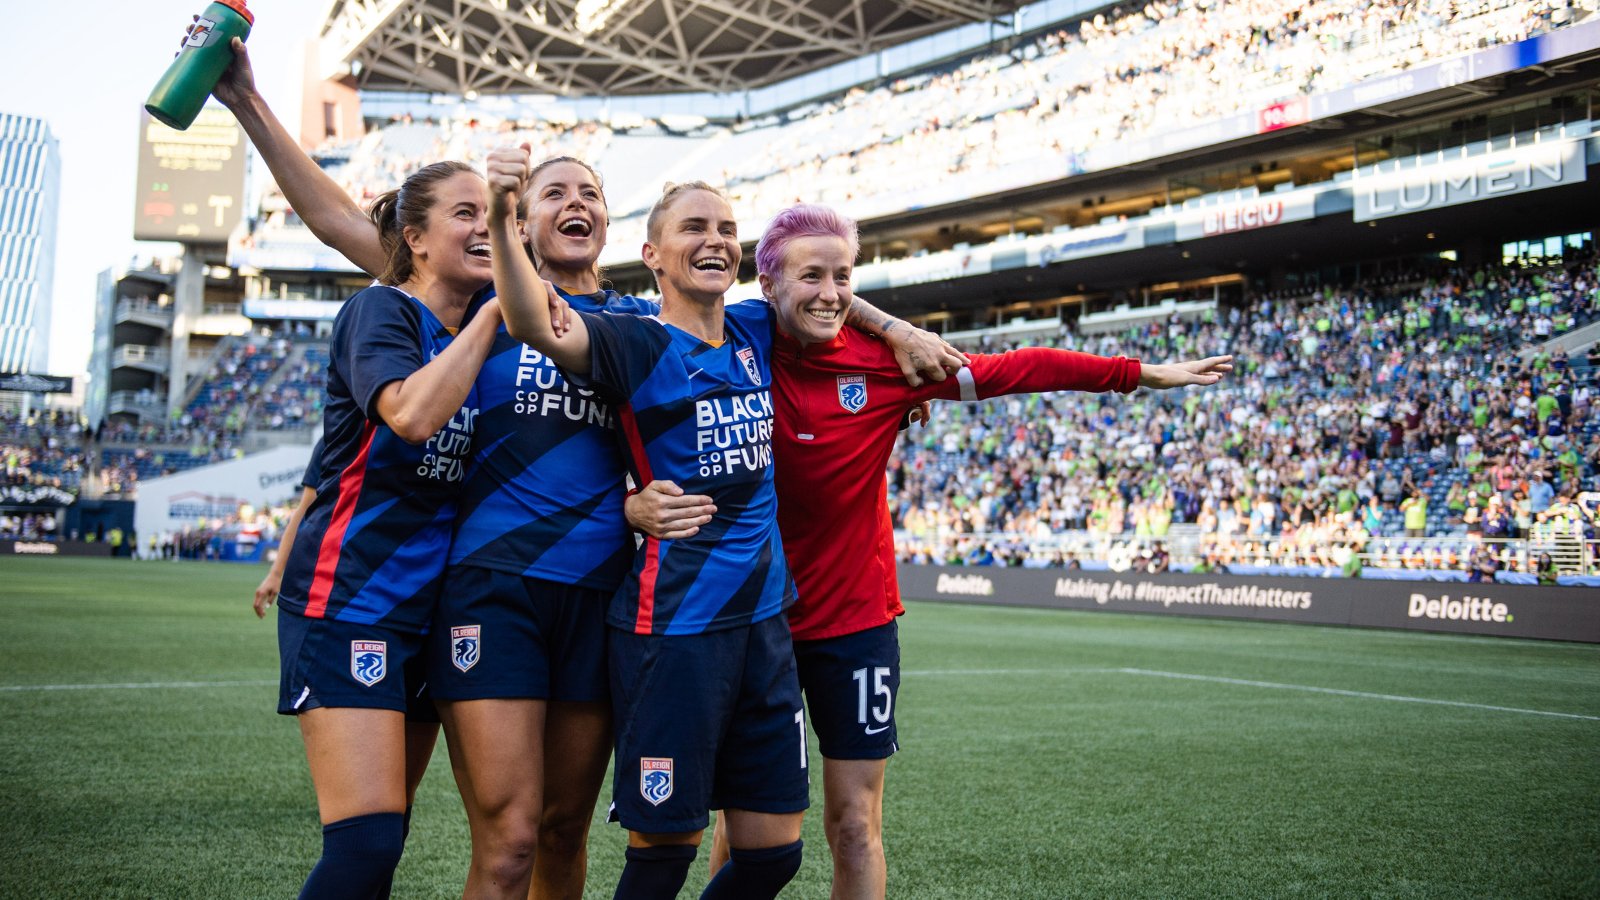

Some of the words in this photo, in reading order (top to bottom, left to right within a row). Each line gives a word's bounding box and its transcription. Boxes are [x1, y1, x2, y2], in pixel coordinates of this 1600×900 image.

[1203, 201, 1284, 238] BECU
[514, 403, 537, 415] OP
[515, 390, 539, 402] CO
[541, 393, 615, 429] FUN
[695, 391, 774, 428] BLACK
[698, 452, 721, 465] CO
[699, 464, 723, 478] OP
[1054, 578, 1109, 604] Making
[1110, 580, 1134, 600] An
[1135, 581, 1312, 609] #ImpactThatMatters
[1407, 593, 1514, 623] Deloitte.
[852, 666, 892, 723] 15
